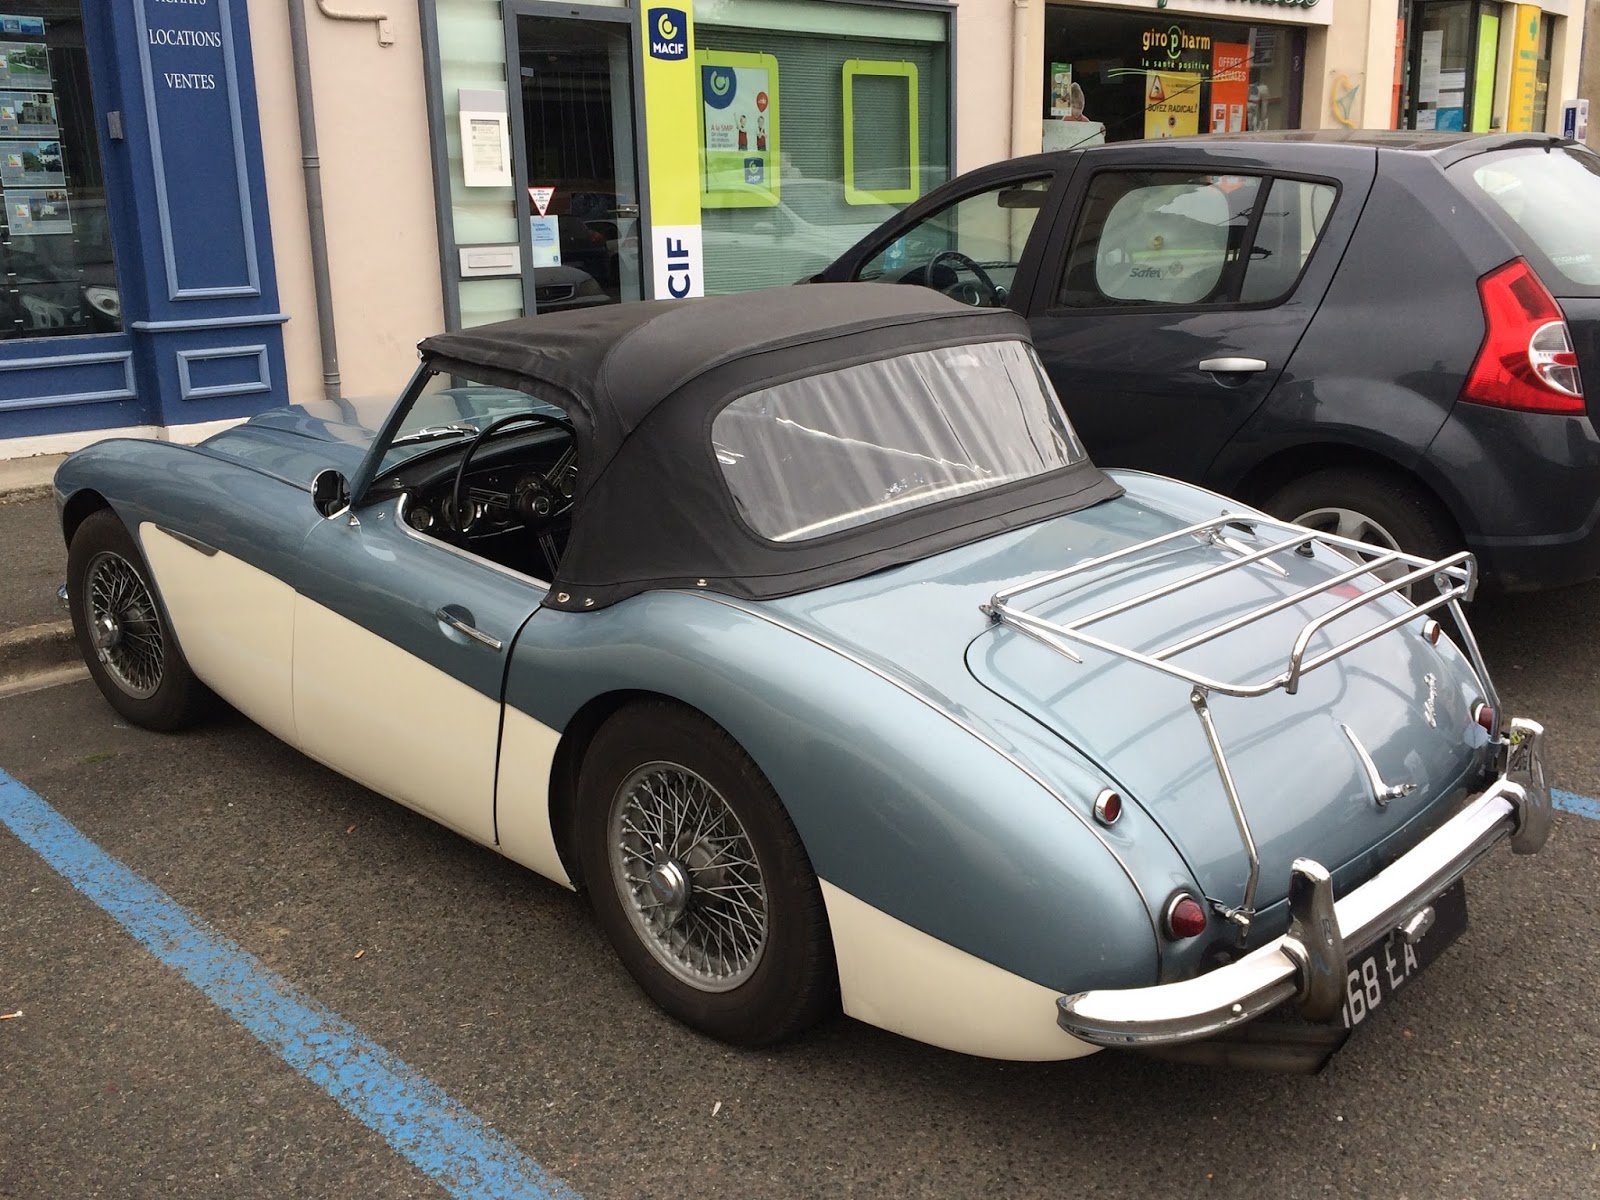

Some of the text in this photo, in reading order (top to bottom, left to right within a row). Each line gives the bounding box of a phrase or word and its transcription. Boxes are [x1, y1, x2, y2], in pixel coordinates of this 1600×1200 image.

[149, 29, 221, 47] LOCATIONS
[652, 42, 684, 54] MACIF
[1141, 57, 1150, 67] la
[1178, 60, 1210, 71] positive
[1218, 56, 1243, 69] OFFRES
[164, 73, 216, 90] VENTES
[666, 237, 691, 299] CIF
